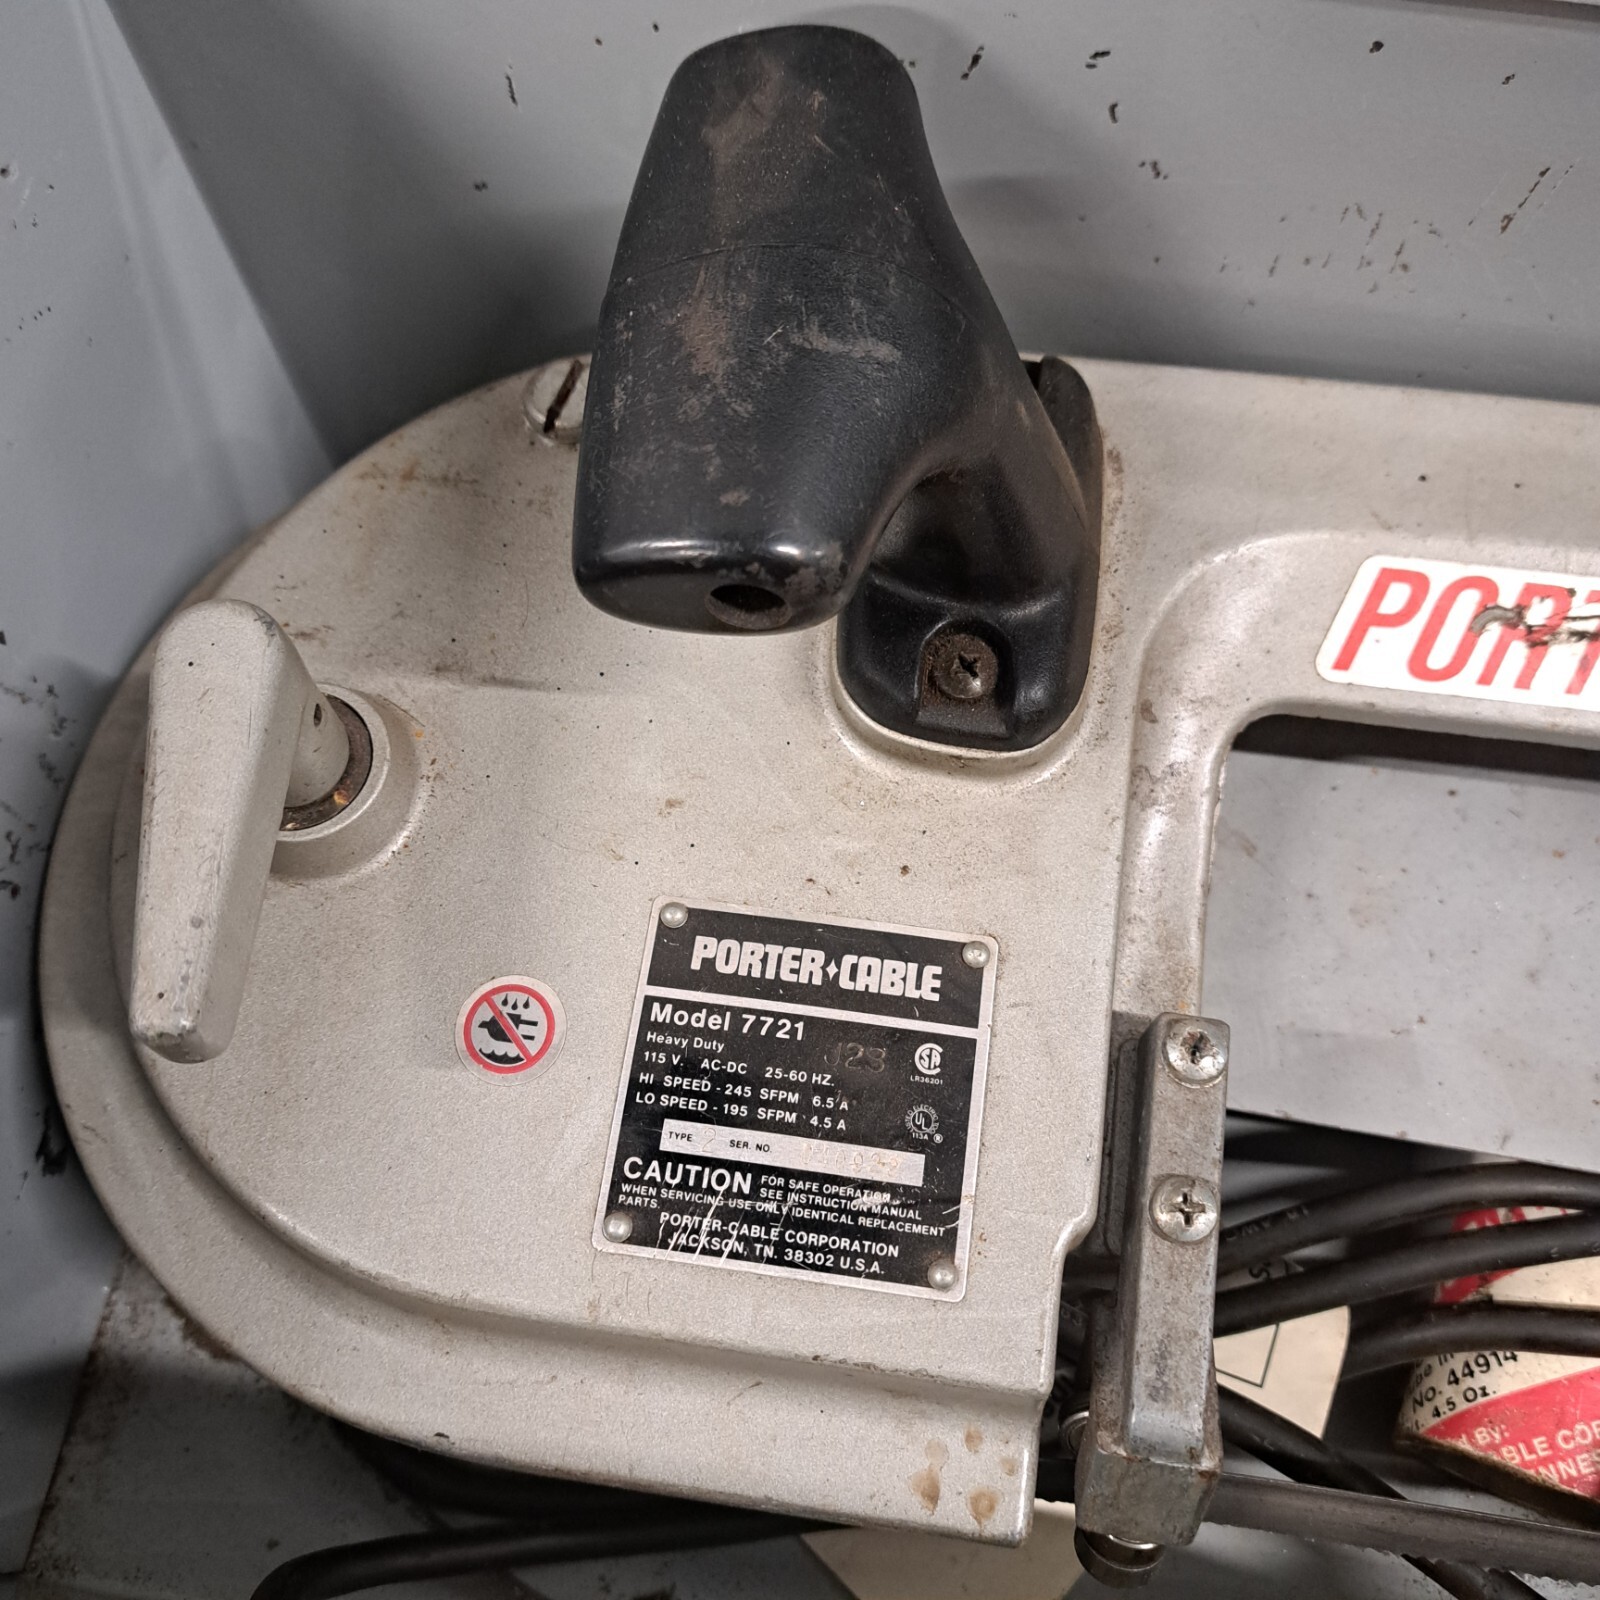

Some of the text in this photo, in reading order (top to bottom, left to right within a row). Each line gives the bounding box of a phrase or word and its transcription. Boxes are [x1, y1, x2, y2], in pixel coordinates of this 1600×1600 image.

[650, 1002, 804, 1041] Model 7721
[646, 1031, 725, 1053] Heavy Duty
[643, 1051, 667, 1064] 115
[700, 1058, 748, 1075] AC-DC
[764, 1066, 808, 1083] 25-60
[811, 1073, 835, 1087] HZ.
[639, 1072, 848, 1111] HI SPEED 245 SFPM 6.5 A
[635, 1091, 846, 1131] LO SPEED 195 SFPM 4.5 A
[668, 1131, 693, 1142] TYPE
[729, 1139, 751, 1150] SER.
[755, 1143, 772, 1153] NO.
[623, 1156, 752, 1194] CAUTION
[761, 1175, 891, 1203] FOR SAFE OPERATION
[618, 1194, 660, 1209] PARTS.
[621, 1183, 946, 1237] WHEN SERVICING USE ONLY IDENTICAL REPLACEMENT
[759, 1188, 922, 1220] SEE INSTRUCTION MANUAL
[659, 1212, 899, 1258] PORTER-CABLE CORPORATION
[668, 1232, 885, 1275] JACKSON, TN. 38302 U.S.A.
[1447, 1351, 1518, 1386] 44914
[1431, 1397, 1456, 1418] 4.5
